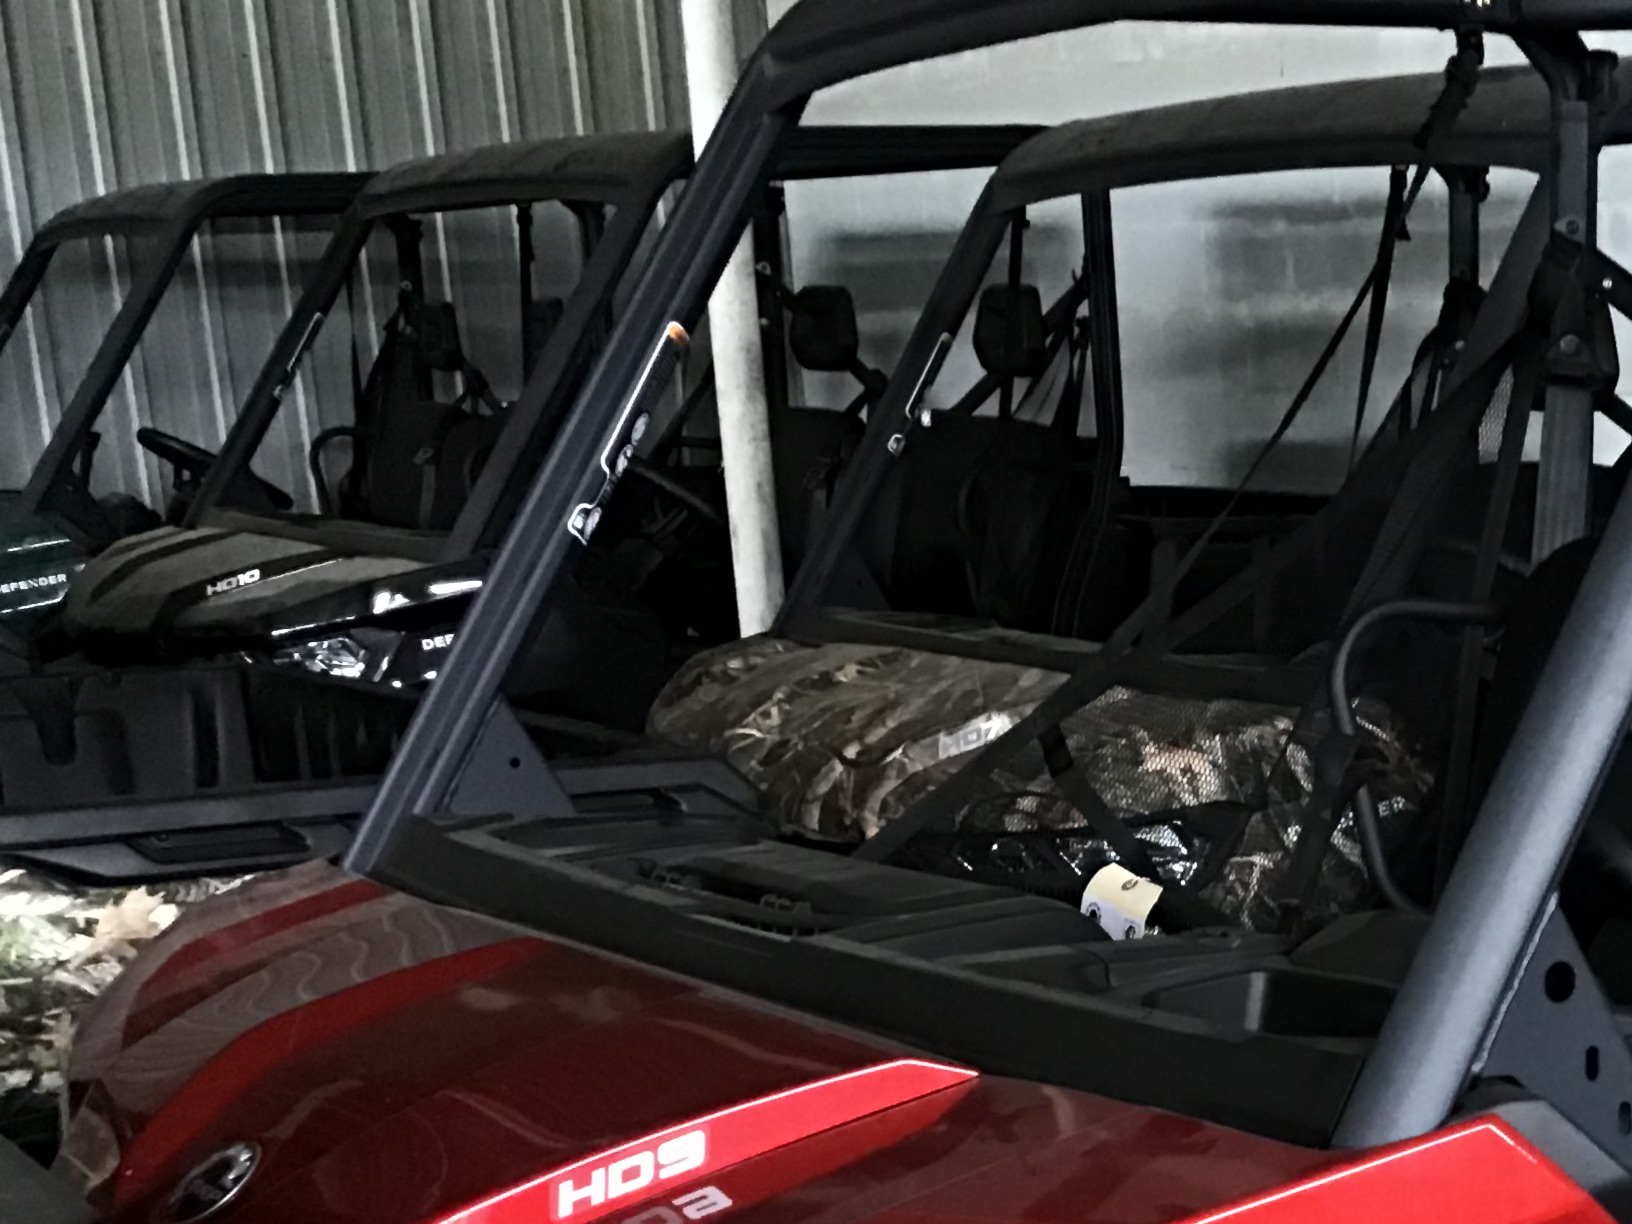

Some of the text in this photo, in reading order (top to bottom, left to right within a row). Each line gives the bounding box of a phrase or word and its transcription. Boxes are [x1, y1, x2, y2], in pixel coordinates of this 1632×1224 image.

[0, 573, 67, 594] EFENDER
[206, 568, 260, 597] HD10
[557, 1129, 707, 1219] HD9
